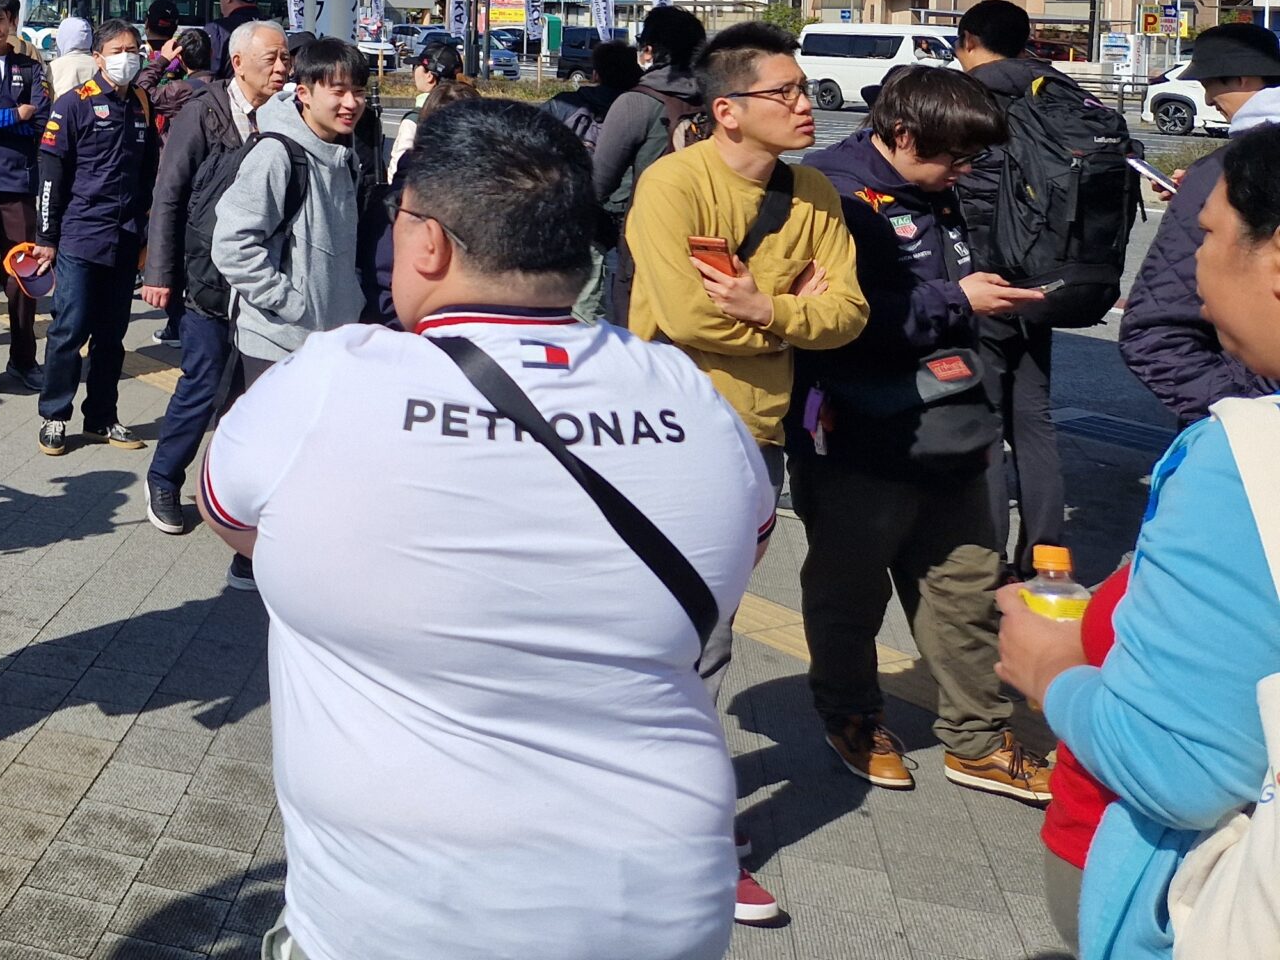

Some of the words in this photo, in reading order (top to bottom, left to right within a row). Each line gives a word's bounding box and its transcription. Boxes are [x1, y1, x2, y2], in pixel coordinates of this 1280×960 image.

[1144, 14, 1158, 32] P
[41, 180, 52, 233] HONDA
[893, 217, 909, 225] TAG
